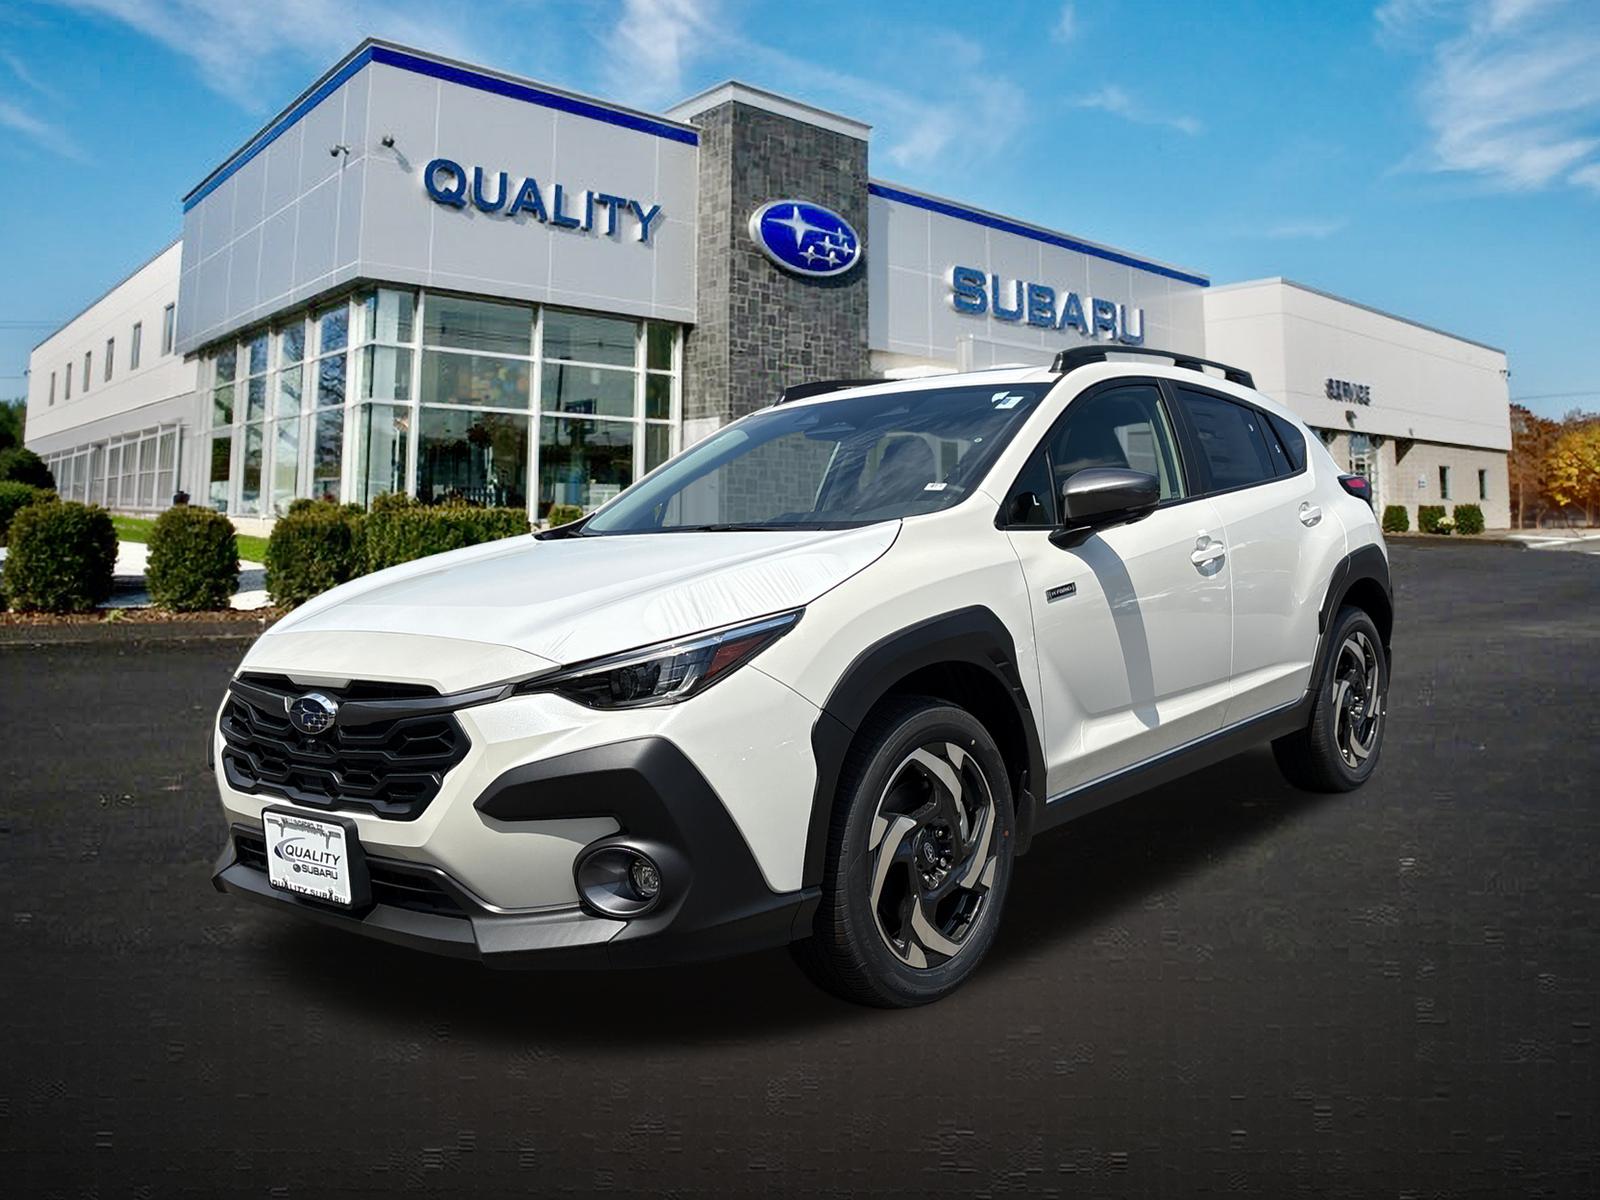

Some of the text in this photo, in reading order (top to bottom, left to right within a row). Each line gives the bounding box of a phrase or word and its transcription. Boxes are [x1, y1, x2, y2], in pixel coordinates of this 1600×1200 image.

[424, 158, 662, 243] QUALITY
[950, 265, 1145, 346] SUBARU
[1324, 378, 1371, 407] SERVICE
[285, 844, 341, 866] QUALITY
[301, 864, 339, 880] SUBARU
